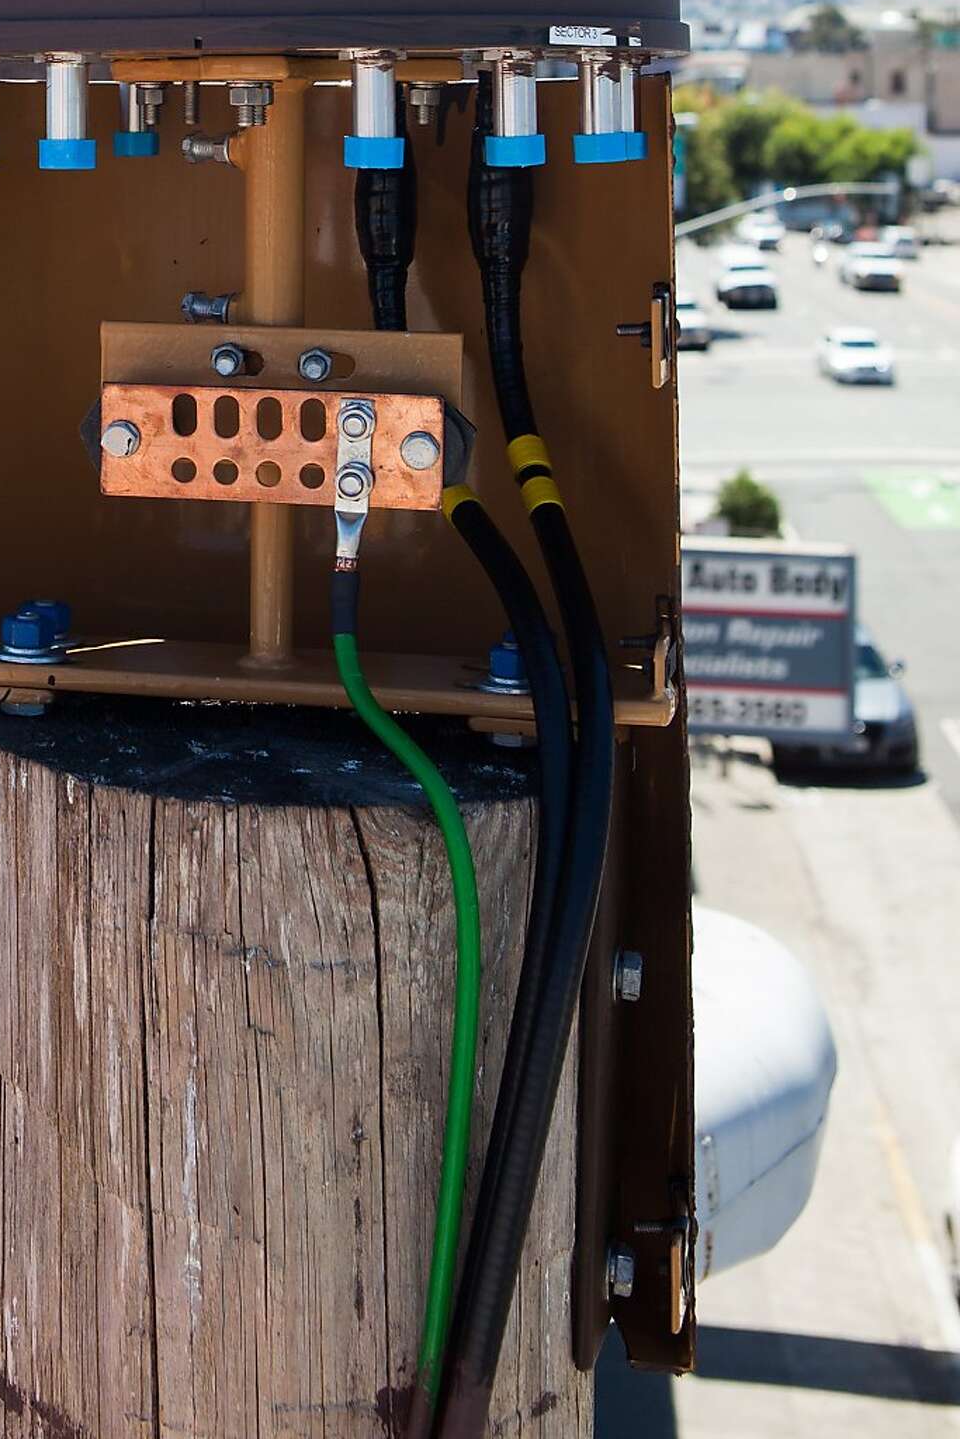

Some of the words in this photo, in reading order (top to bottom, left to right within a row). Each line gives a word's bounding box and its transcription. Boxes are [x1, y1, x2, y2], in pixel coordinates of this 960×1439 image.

[554, 26, 591, 38] SECTOR
[592, 28, 598, 39] 3
[688, 560, 757, 593] Auto
[770, 562, 848, 601] Body
[726, 619, 823, 651] Repair
